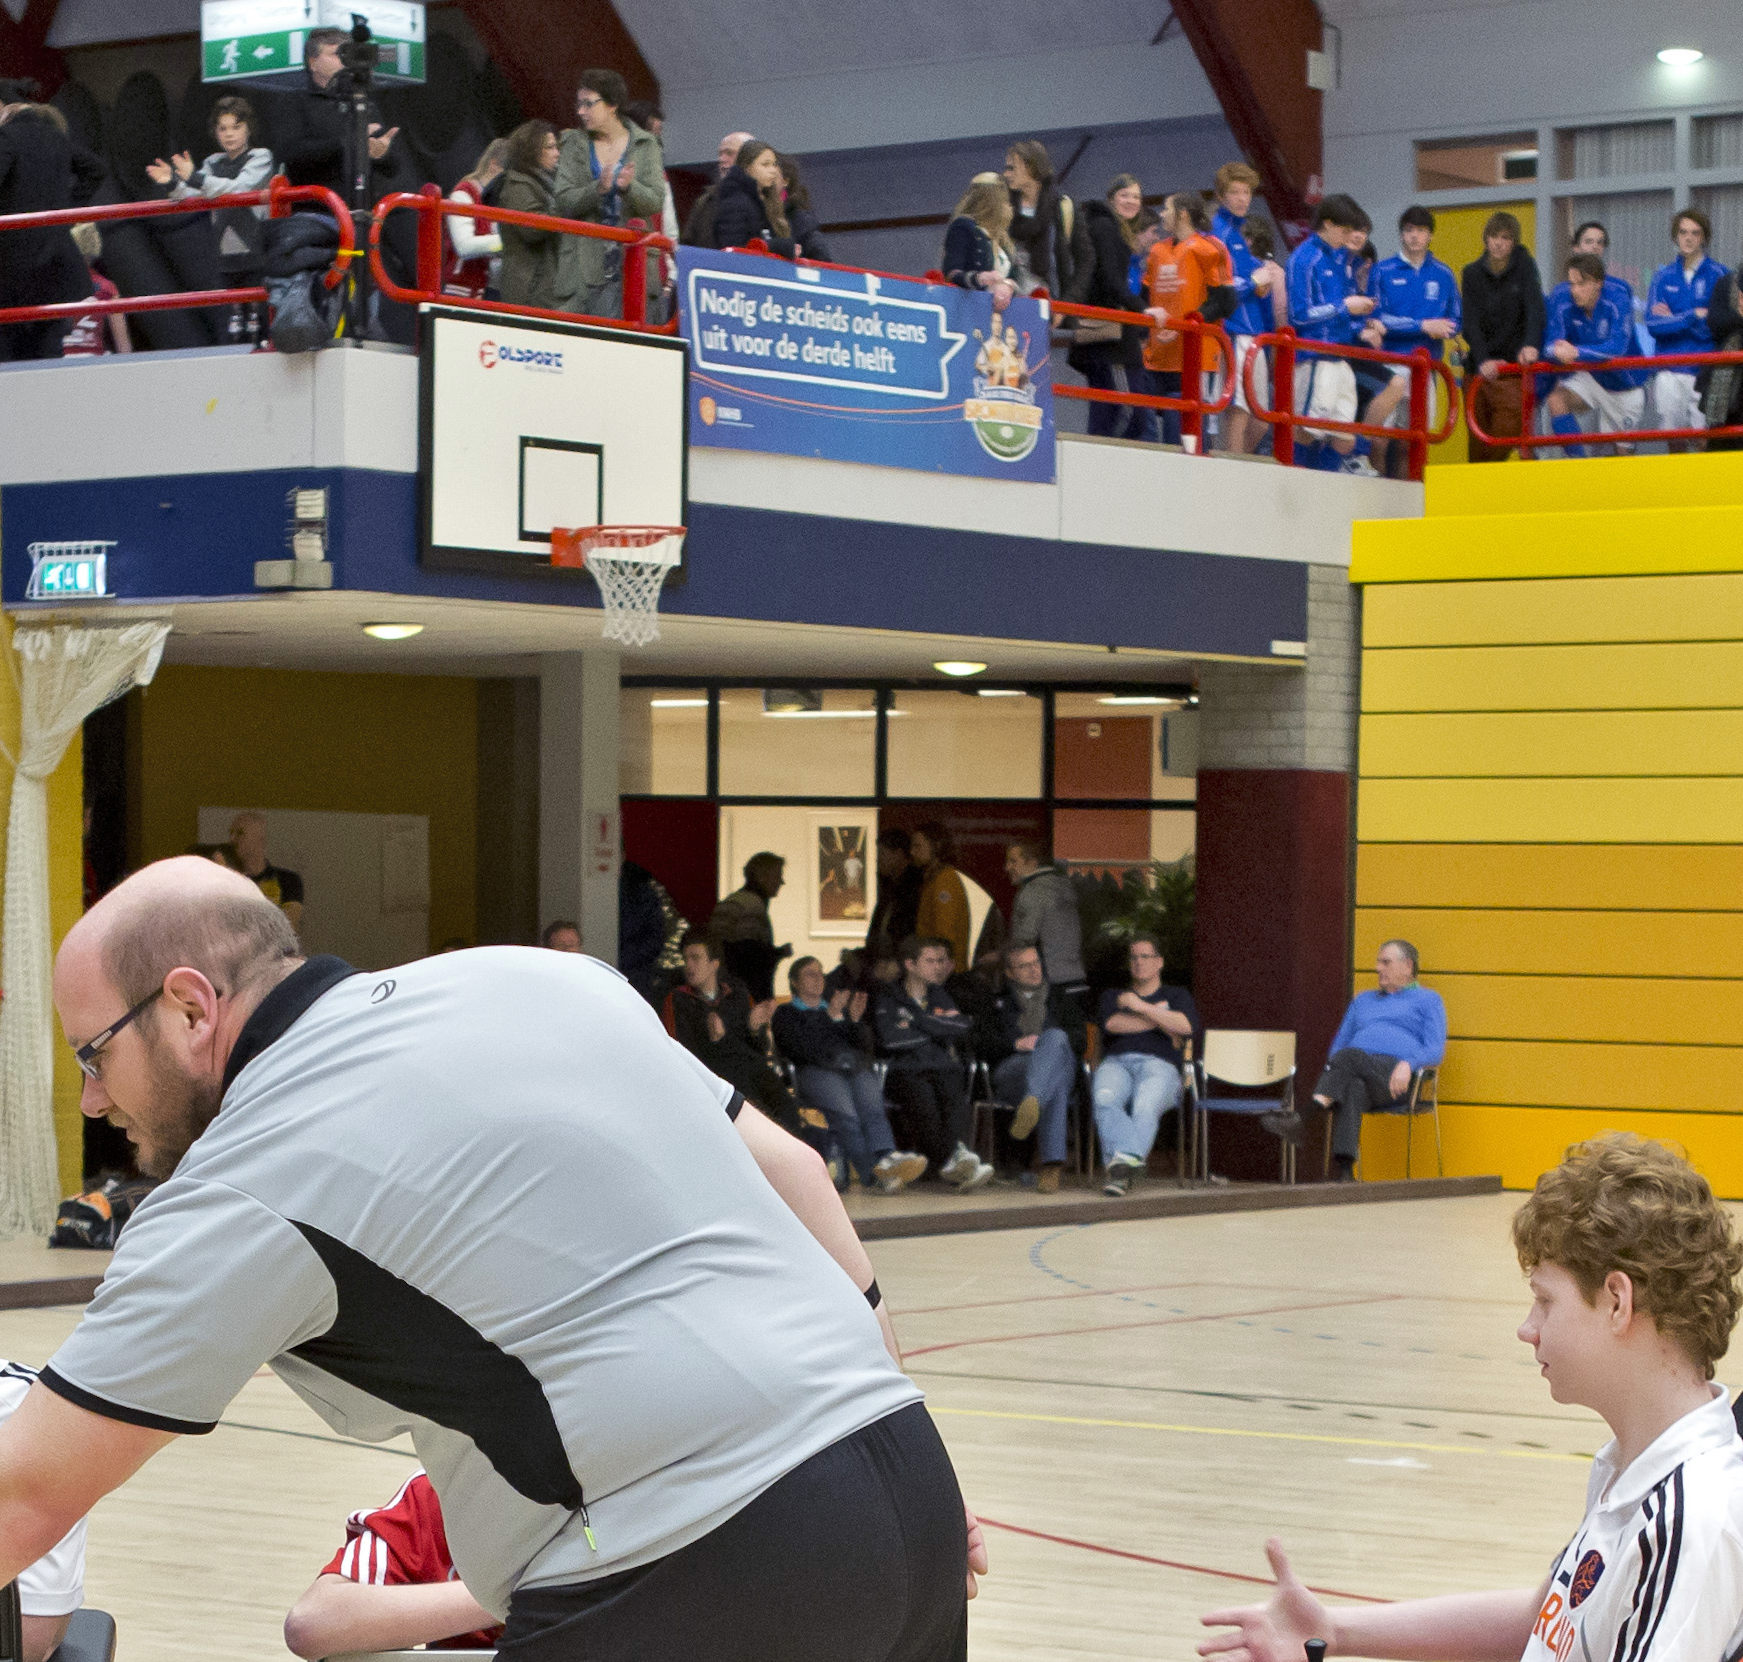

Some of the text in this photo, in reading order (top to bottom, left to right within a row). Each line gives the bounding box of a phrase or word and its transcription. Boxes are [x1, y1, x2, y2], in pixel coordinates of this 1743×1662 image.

[700, 287, 928, 344] Nodig de scheids ook eens
[703, 325, 897, 374] uit voor de derde helft
